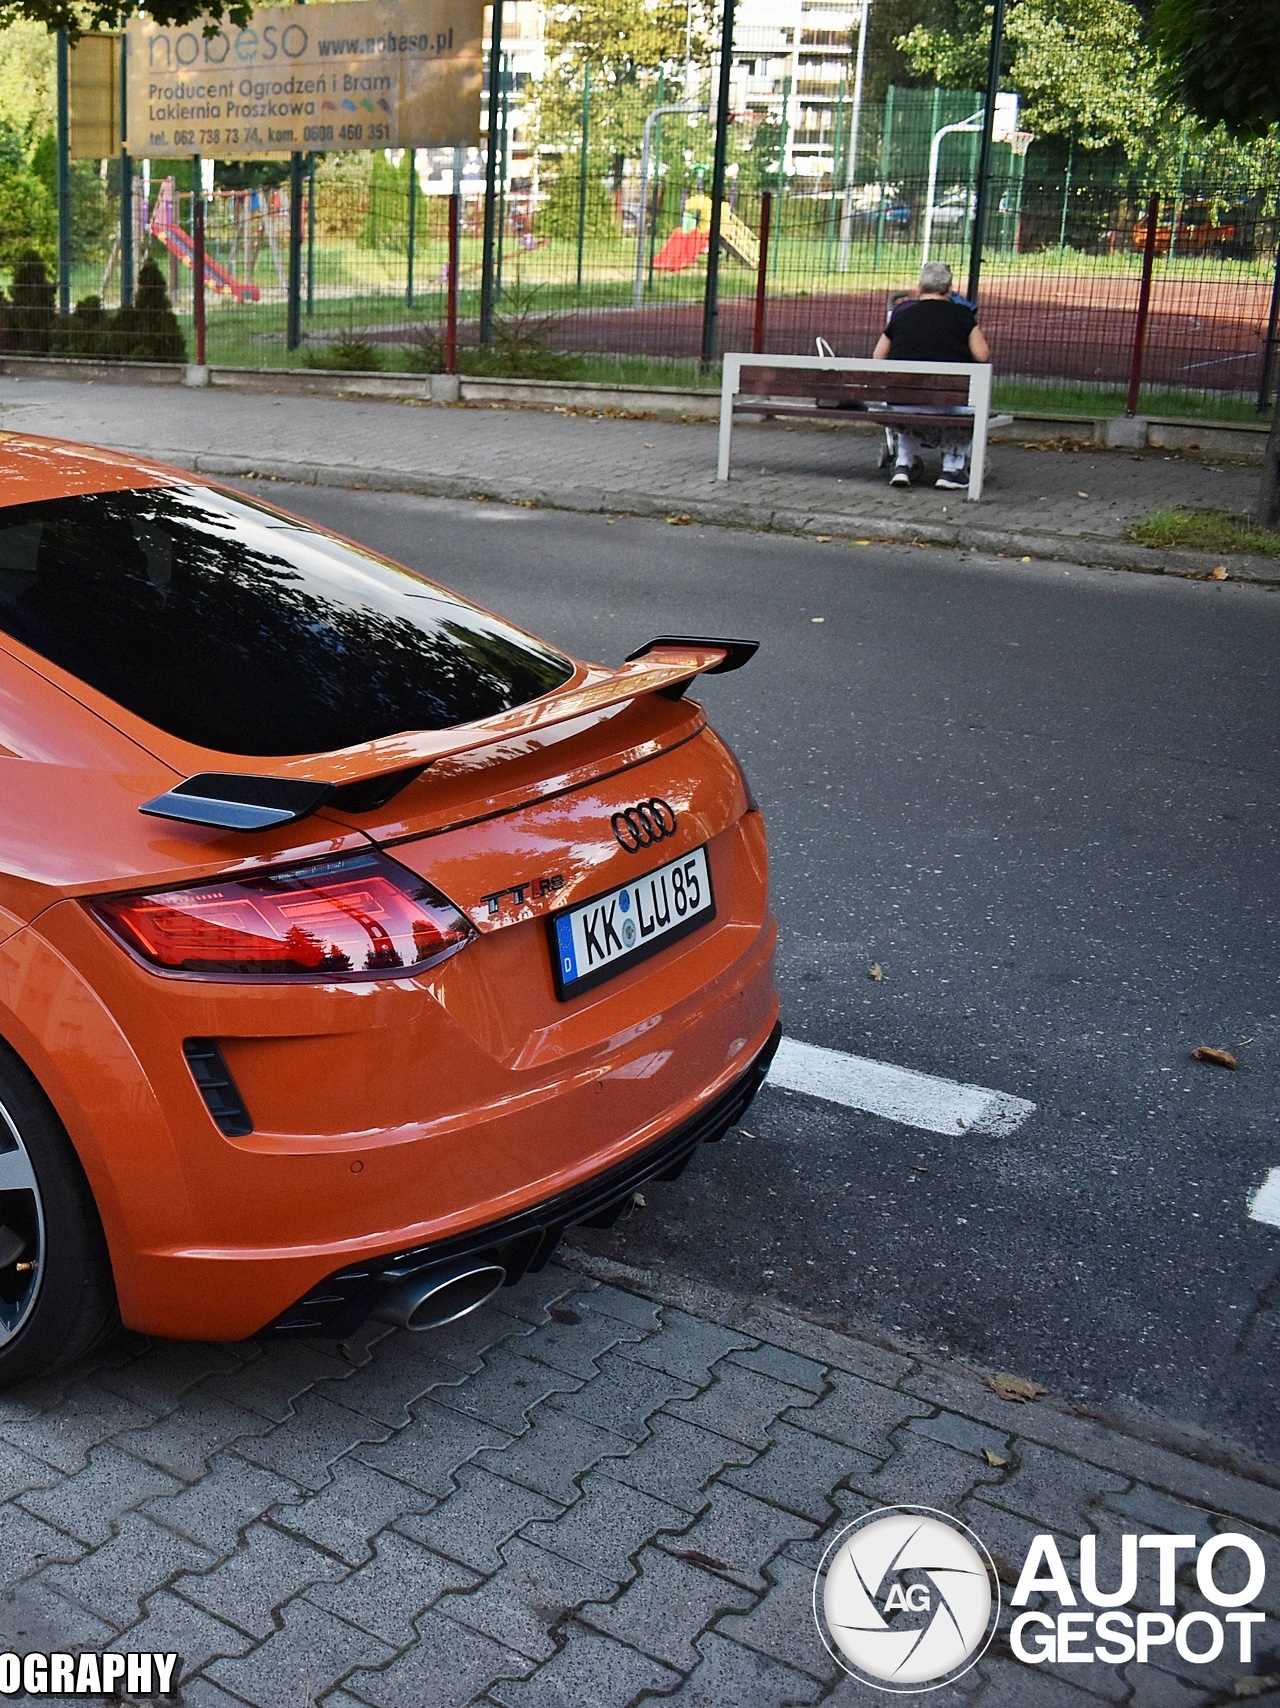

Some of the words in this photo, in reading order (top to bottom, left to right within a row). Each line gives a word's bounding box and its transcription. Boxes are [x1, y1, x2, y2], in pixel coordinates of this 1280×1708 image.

[149, 22, 308, 66] nobeso
[318, 28, 454, 57] www.nobeso.pl
[149, 82, 234, 100] Producent
[239, 75, 326, 100] Ogrodzeń
[343, 74, 391, 92] Bram
[149, 102, 221, 121] Lakiernia
[227, 99, 316, 118] Proszkowa
[174, 129, 194, 145] 062
[200, 128, 220, 144] 738
[225, 128, 239, 144] 73
[268, 126, 298, 142] kom.
[339, 124, 363, 140] 460
[369, 123, 391, 140] 351
[480, 883, 532, 914] TT
[582, 899, 623, 965] KK
[563, 957, 572, 973] D
